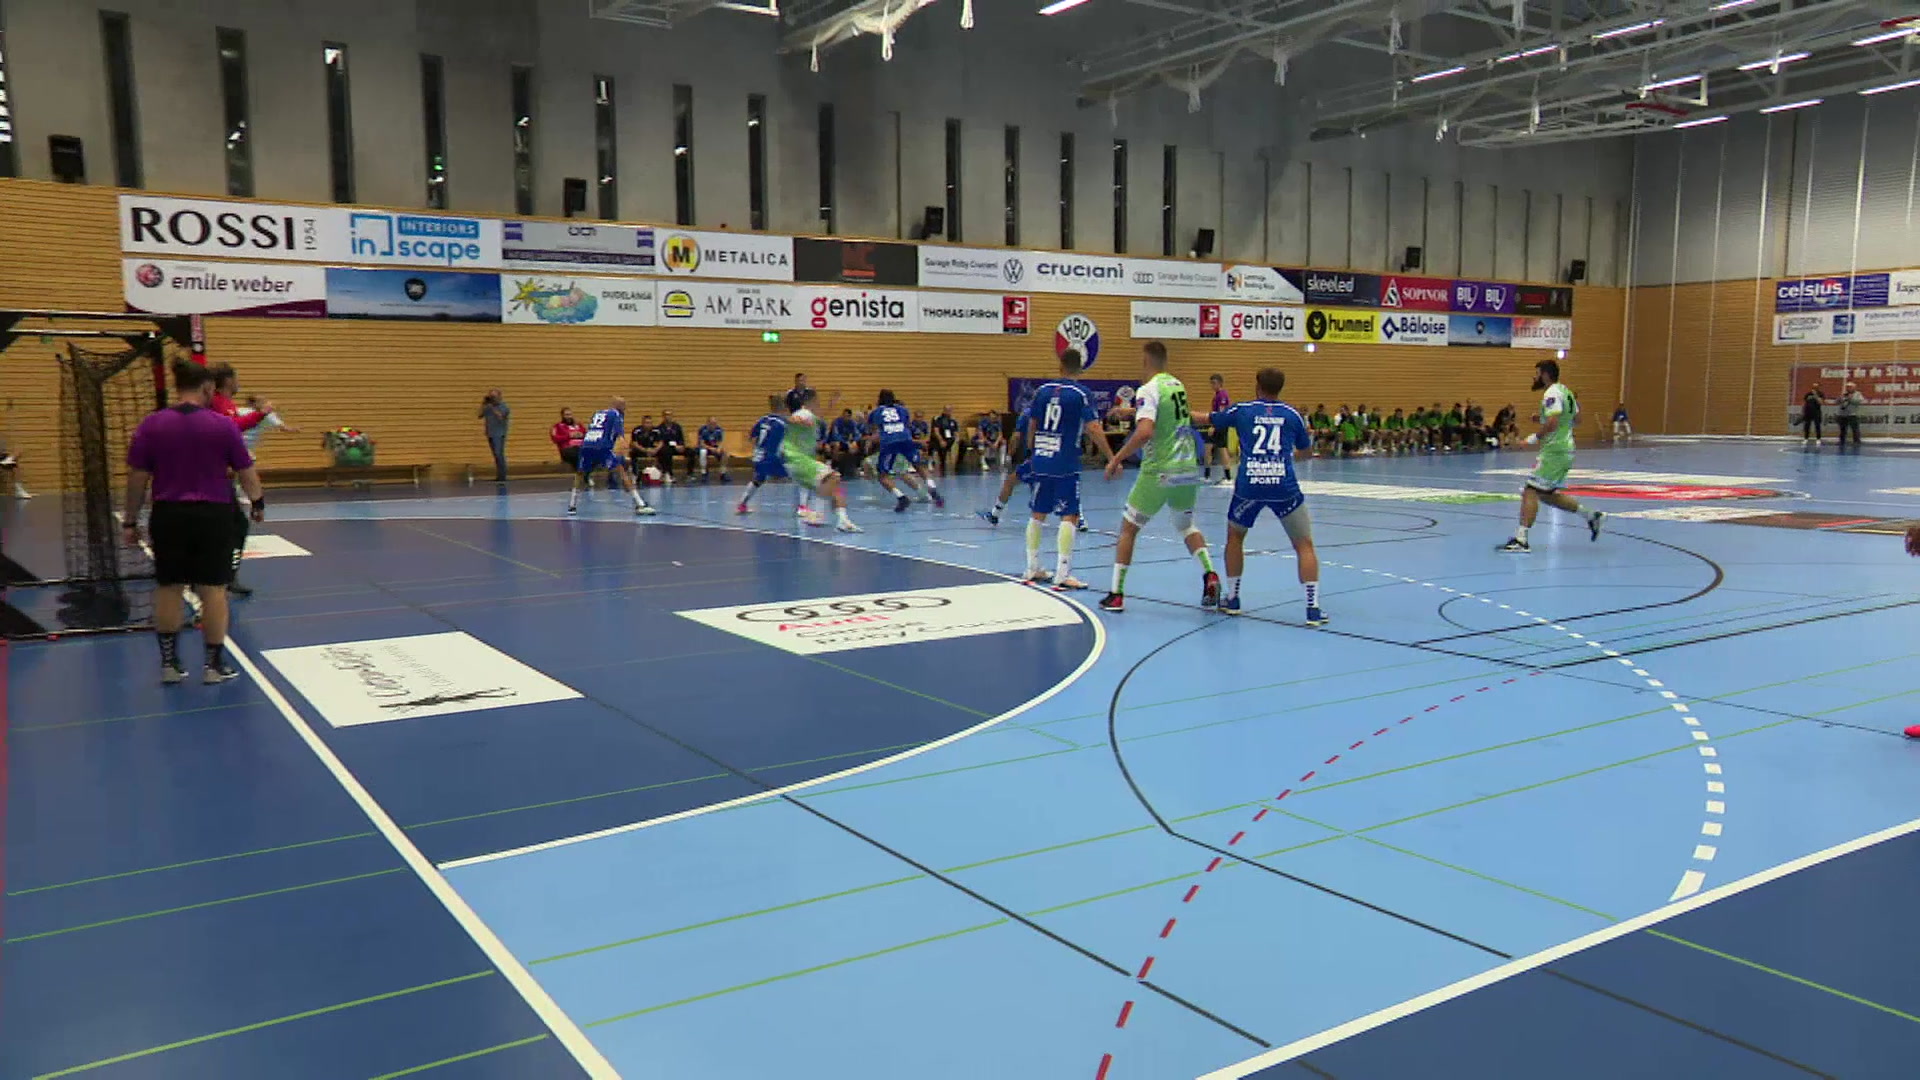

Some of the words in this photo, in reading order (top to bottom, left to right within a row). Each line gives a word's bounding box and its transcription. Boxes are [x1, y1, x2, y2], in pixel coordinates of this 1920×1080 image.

[131, 207, 296, 250] ROSSI
[304, 218, 317, 250] 1954
[400, 219, 477, 236] INTERIORS
[397, 240, 481, 265] scape
[704, 250, 788, 266] METALICA
[1037, 263, 1124, 278] cruciani
[171, 274, 228, 291] emile
[232, 276, 293, 292] weber
[1307, 274, 1354, 293] skeeled
[1402, 287, 1448, 302] SOPINOR
[704, 296, 732, 314] AM
[742, 297, 791, 316] PARK
[811, 292, 904, 328] genista
[1231, 309, 1294, 338] genista
[1329, 313, 1374, 332] hummel
[1400, 316, 1446, 334] Bâloise
[1171, 391, 1189, 420] 15
[1043, 402, 1062, 431] 19
[1252, 425, 1282, 455] 24
